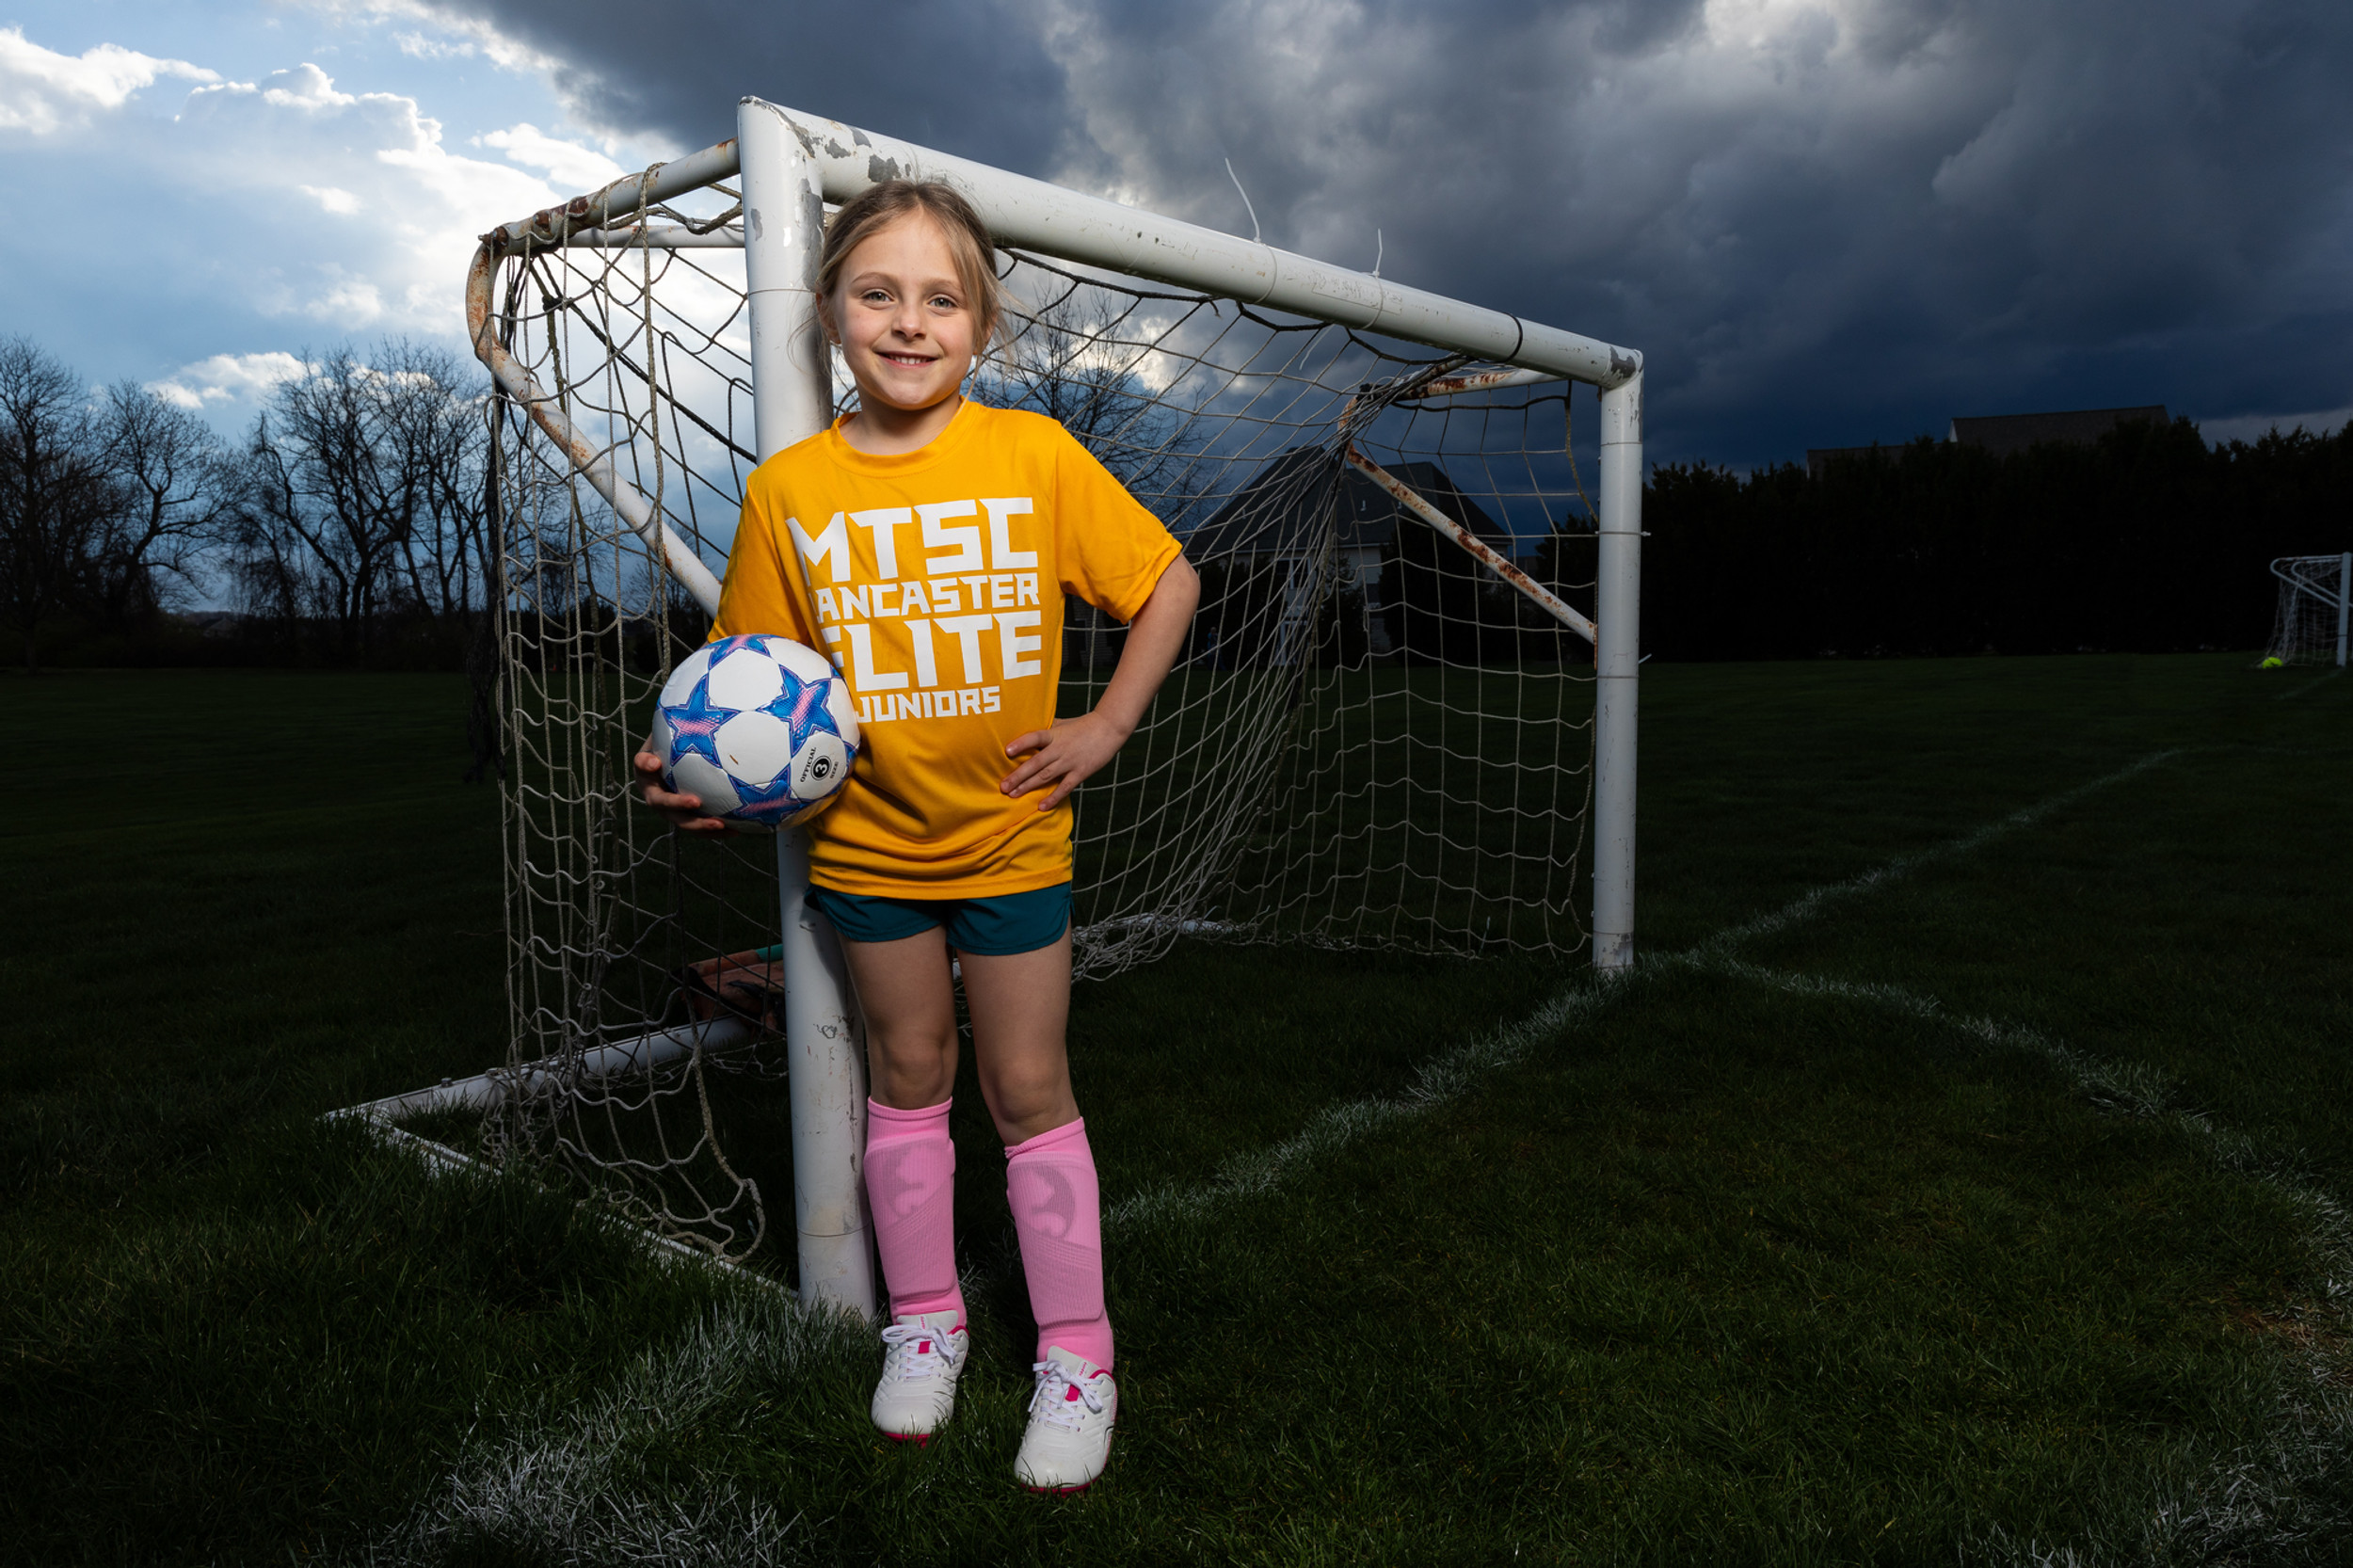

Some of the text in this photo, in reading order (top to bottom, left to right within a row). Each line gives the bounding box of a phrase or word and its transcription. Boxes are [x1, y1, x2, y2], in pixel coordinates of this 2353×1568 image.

[785, 497, 1038, 586] MTSC
[855, 685, 1001, 724] JUNIORS
[800, 746, 817, 783] OFFICIAL
[814, 763, 828, 775] 3
